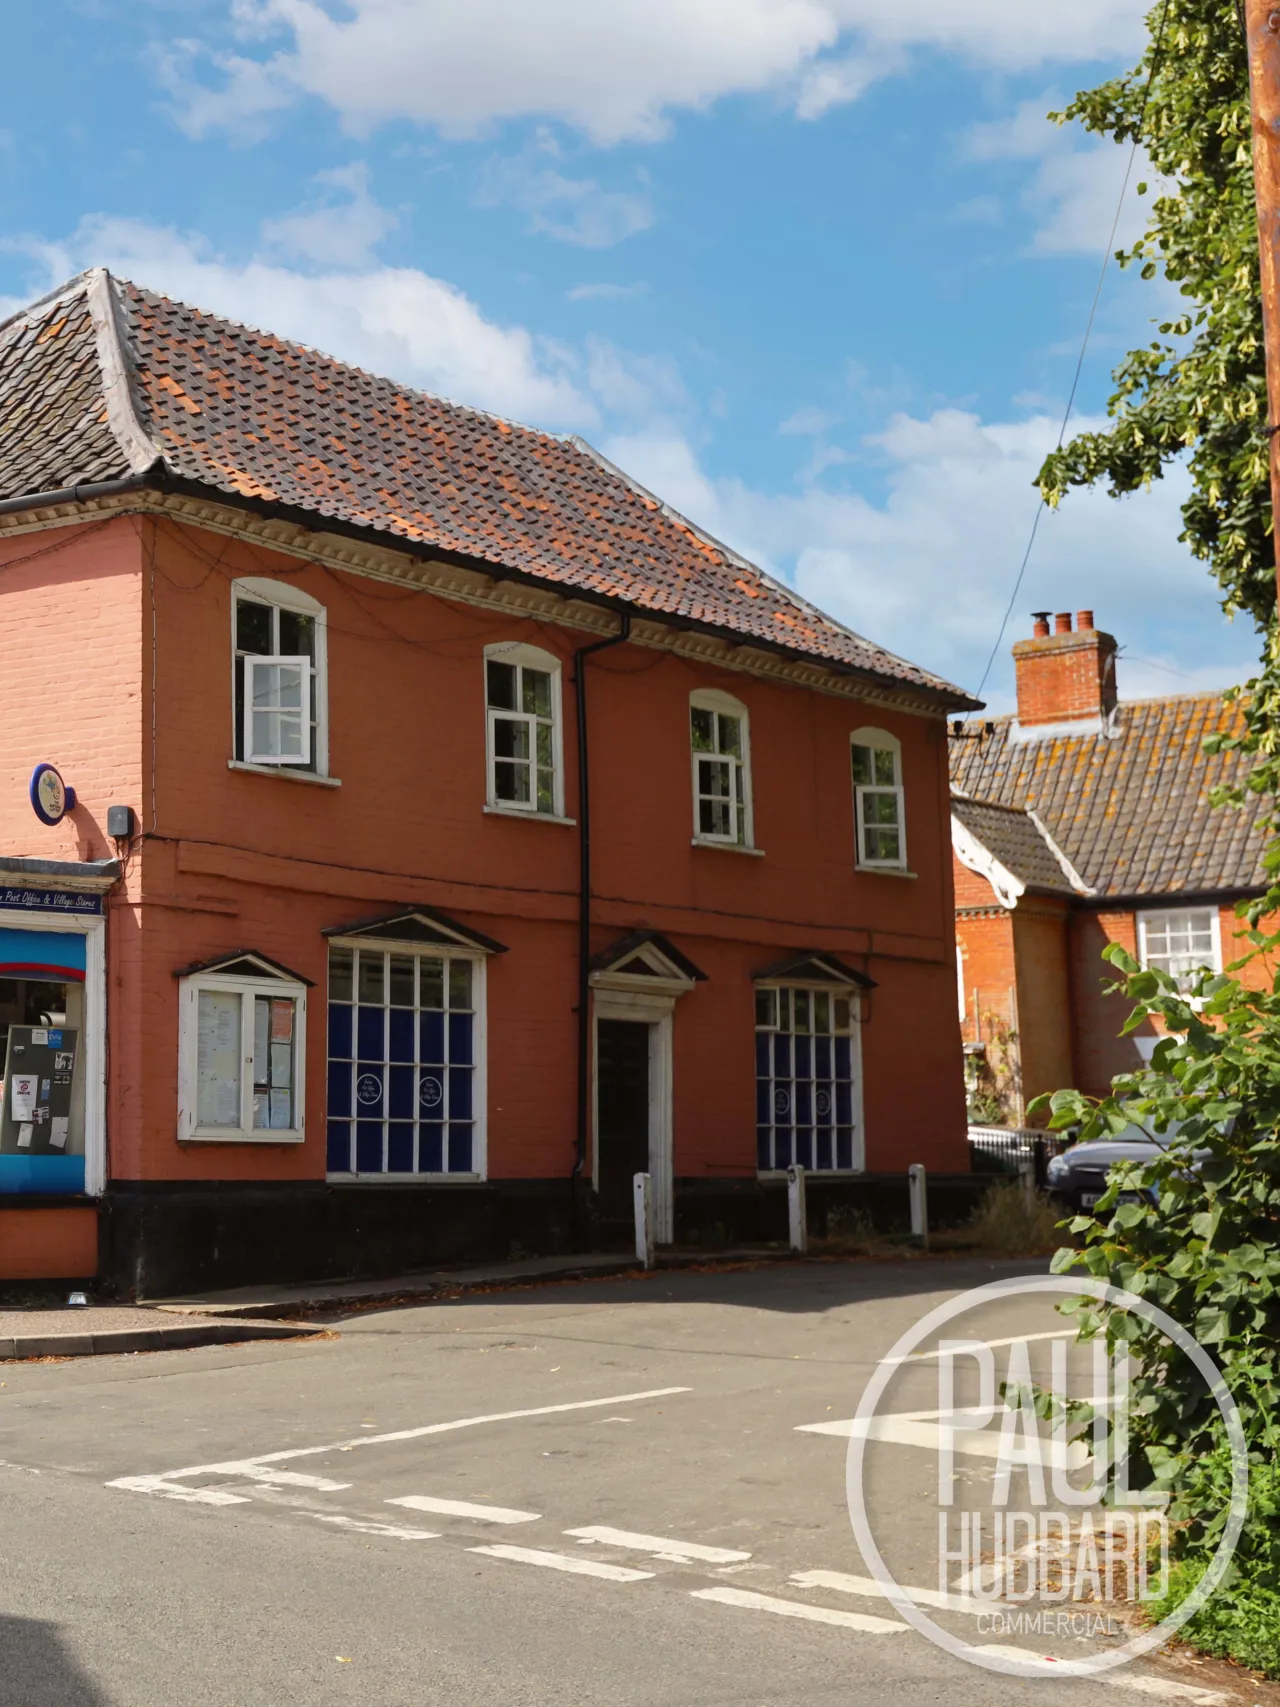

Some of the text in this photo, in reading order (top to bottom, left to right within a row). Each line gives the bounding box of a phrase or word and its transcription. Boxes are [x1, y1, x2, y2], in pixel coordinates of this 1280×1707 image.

[5, 891, 19, 902] Post
[22, 892, 41, 906] Office
[44, 896, 50, 905] &
[53, 894, 73, 909] Village
[75, 896, 96, 908] Stores
